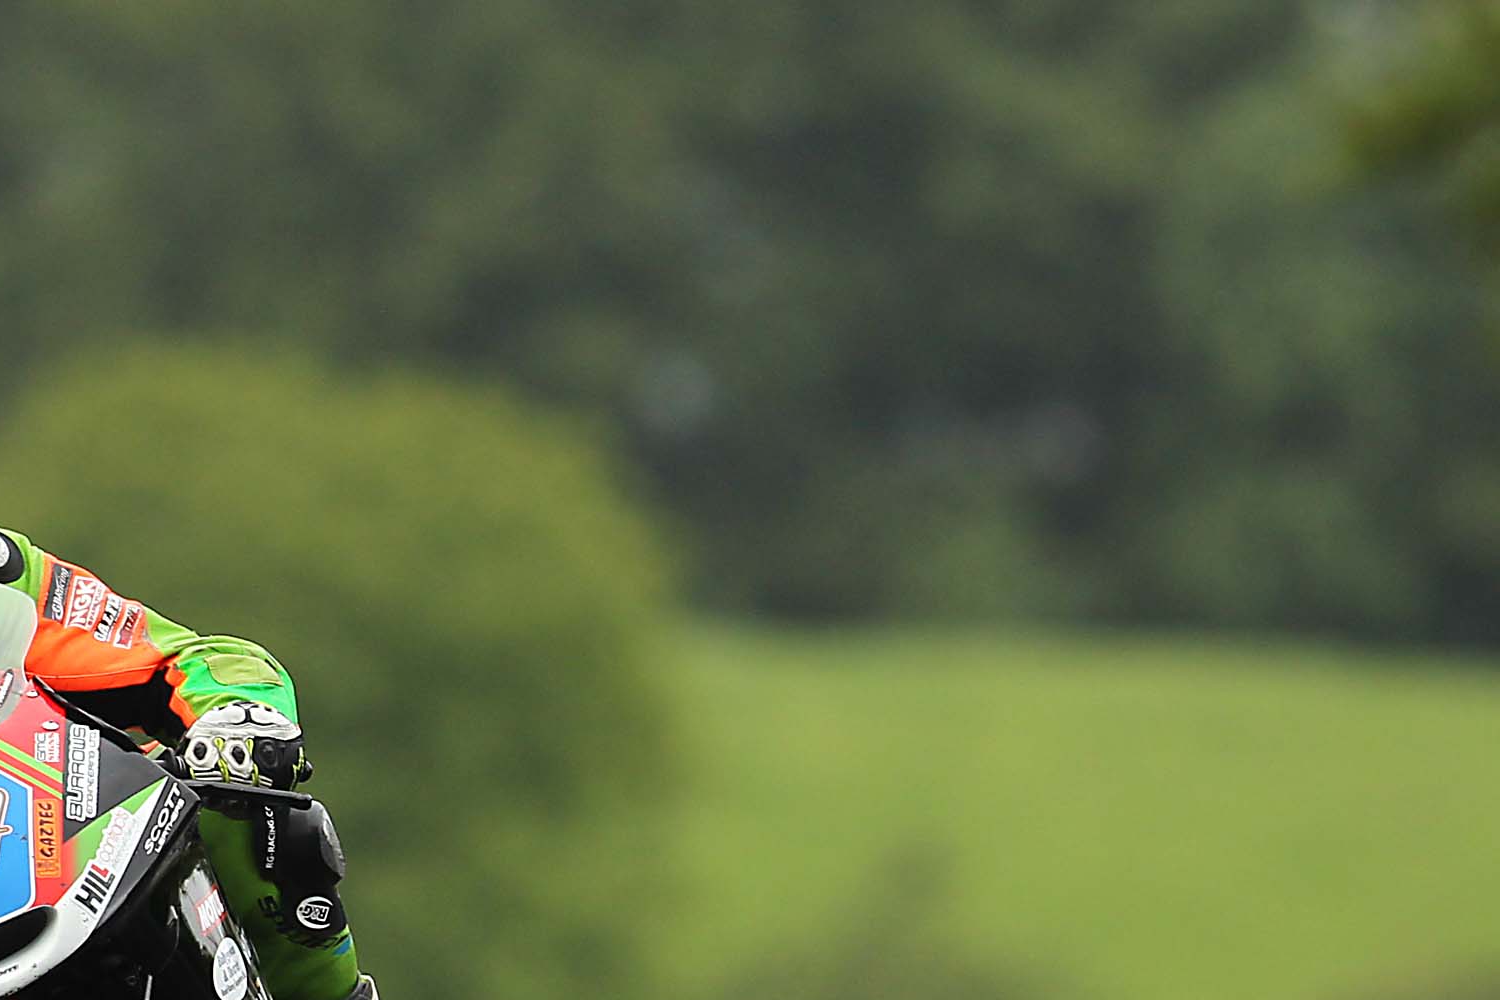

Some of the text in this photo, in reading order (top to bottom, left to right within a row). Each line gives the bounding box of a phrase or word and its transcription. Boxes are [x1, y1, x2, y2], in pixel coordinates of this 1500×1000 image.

[67, 579, 97, 626] NGK
[39, 802, 55, 857] GAZTEC
[144, 782, 181, 855] SCOTT
[74, 863, 115, 915] HILL
